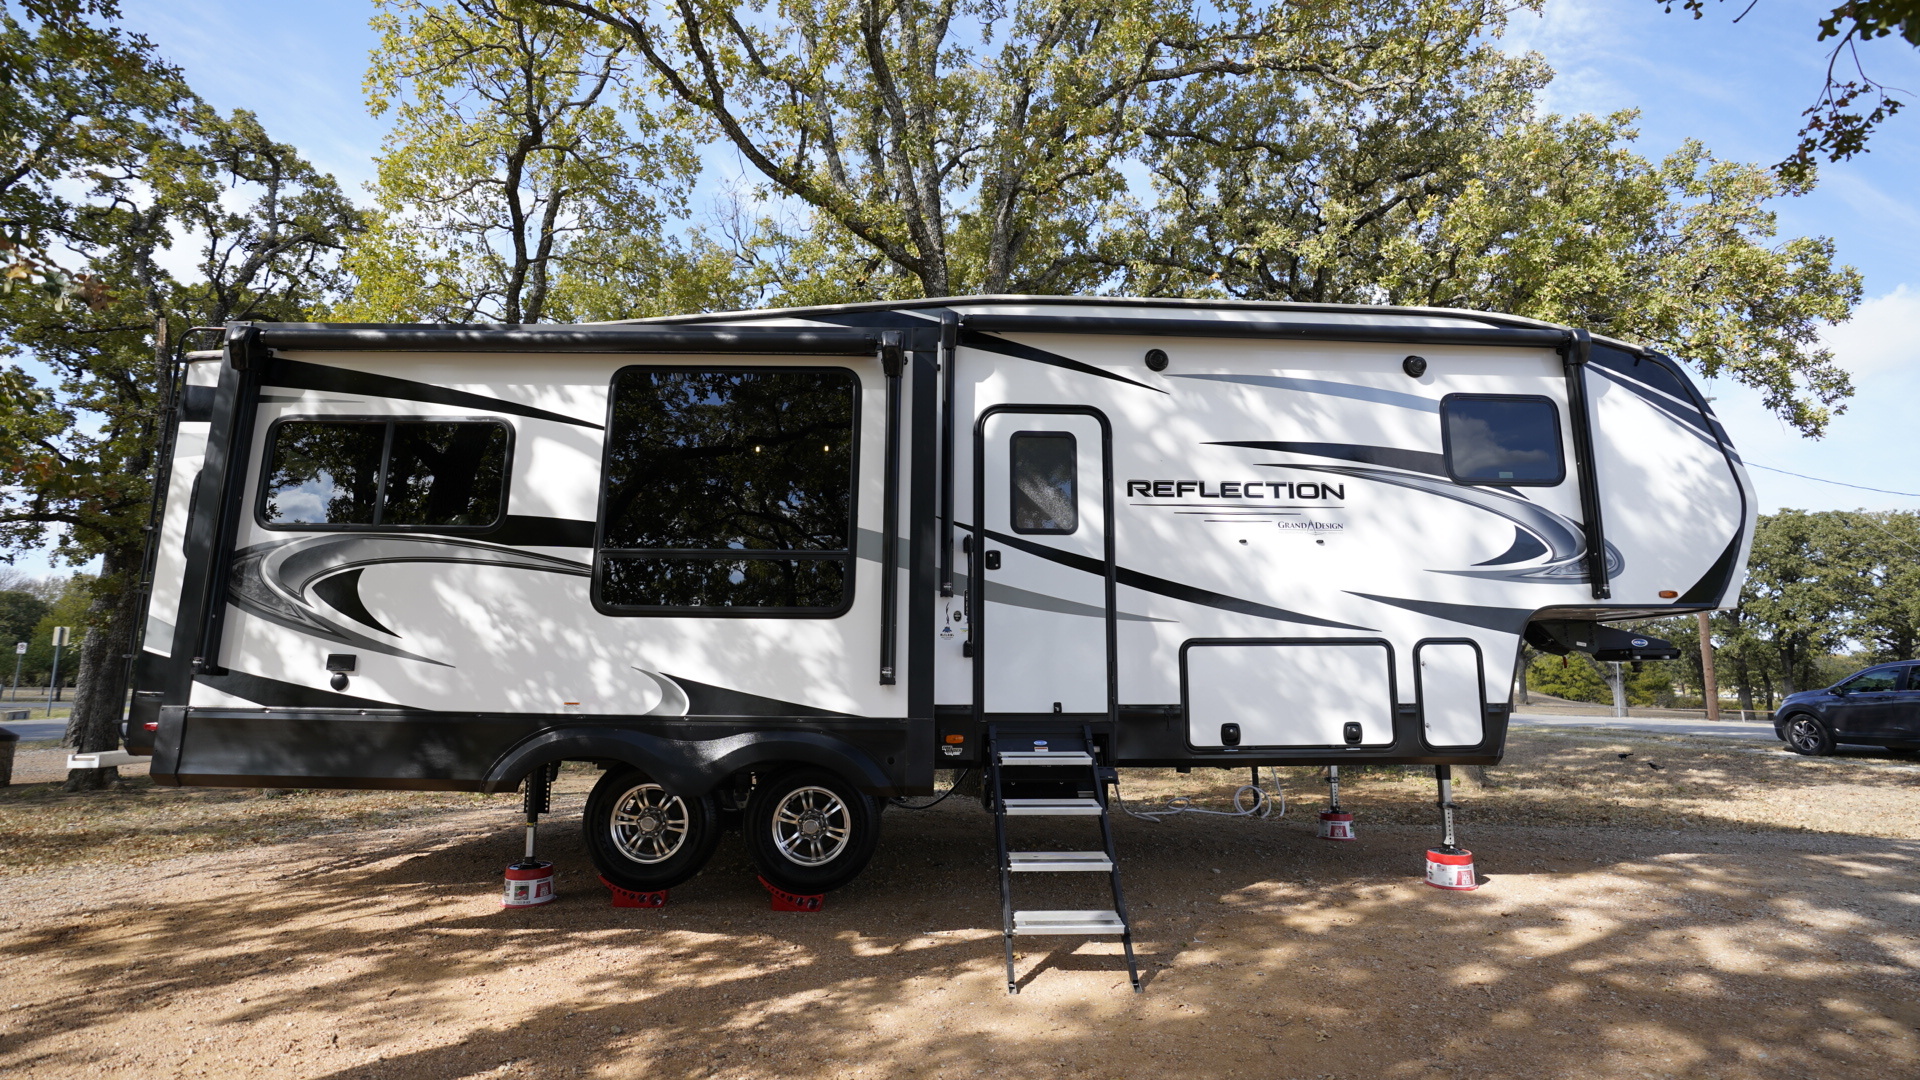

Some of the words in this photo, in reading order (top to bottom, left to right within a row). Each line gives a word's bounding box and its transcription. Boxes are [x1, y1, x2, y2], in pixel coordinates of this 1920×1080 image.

[1127, 480, 1345, 500] REFLECTION
[1278, 521, 1307, 529] GRAND
[1315, 522, 1344, 530] DESIGN
